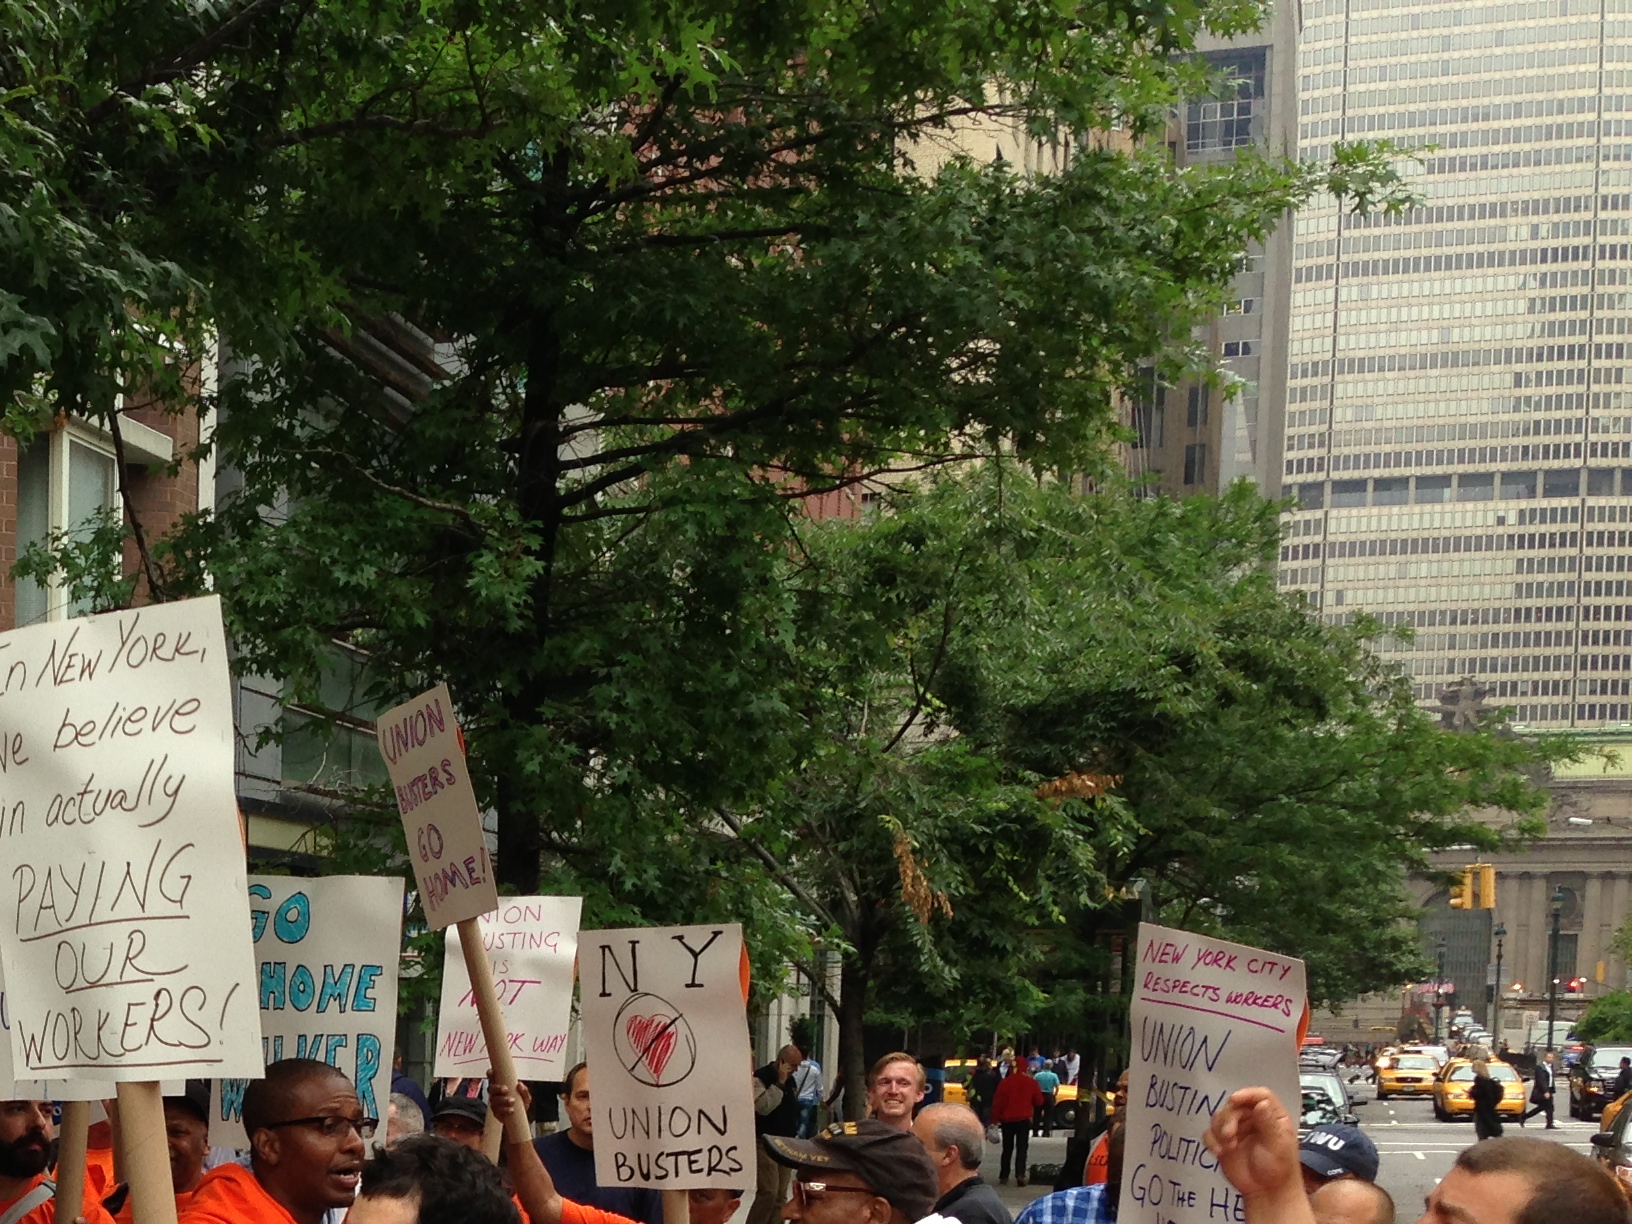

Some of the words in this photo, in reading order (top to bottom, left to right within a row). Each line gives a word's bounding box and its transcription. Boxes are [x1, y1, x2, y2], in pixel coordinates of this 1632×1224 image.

[36, 626, 98, 688] NEW
[108, 612, 206, 674] YORK,
[53, 699, 201, 752] believe
[382, 698, 445, 765] UNION
[45, 754, 186, 828] actually
[396, 758, 456, 815] BUSTERS
[418, 823, 443, 863] GO
[13, 838, 195, 938] PAYING
[423, 846, 487, 912] HOME!
[248, 884, 310, 944] GO
[54, 929, 189, 990] OUR
[483, 931, 560, 953] USTING
[493, 959, 509, 976] IS
[1142, 938, 1189, 965] NEW
[1191, 948, 1236, 971] YORK
[1247, 957, 1292, 981] CITY
[260, 962, 383, 1014] HOME
[1142, 971, 1221, 1003] RESPECTS
[1225, 988, 1292, 1016] WORKERS
[18, 983, 240, 1067] WORKERS!
[440, 1030, 480, 1057] NEW
[532, 1033, 566, 1053] WAY
[1141, 1016, 1232, 1073] UNION
[1145, 1074, 1227, 1117] BUSTIN
[607, 1105, 729, 1139] UNION
[614, 1144, 744, 1182] BUSTERS
[1131, 1164, 1164, 1209] GO
